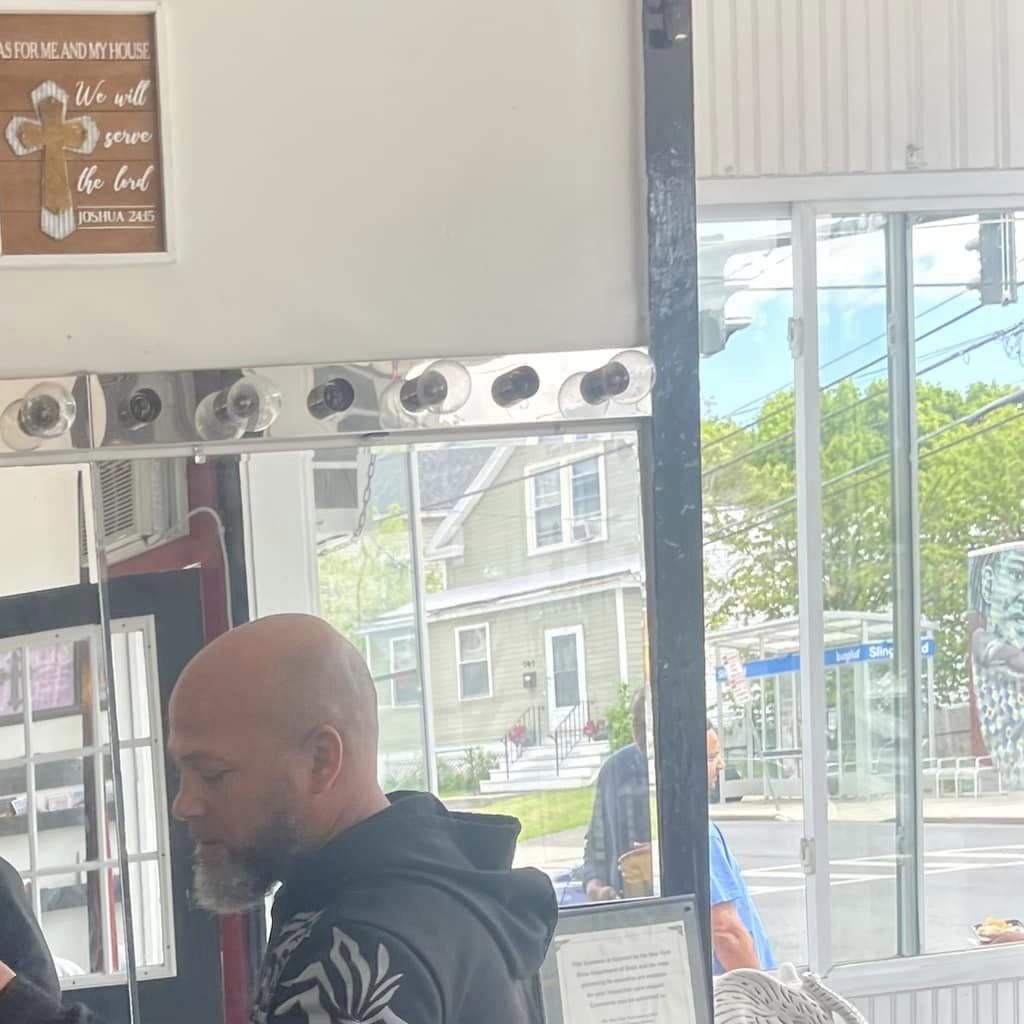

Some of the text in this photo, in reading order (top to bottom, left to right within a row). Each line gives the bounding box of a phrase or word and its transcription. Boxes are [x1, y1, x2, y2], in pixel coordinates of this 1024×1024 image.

[14, 41, 39, 59] FOR
[40, 41, 59, 60] ME
[60, 41, 88, 60] AND
[89, 41, 109, 60] MY
[109, 41, 151, 60] HOUSE
[75, 79, 151, 108] We will
[103, 129, 153, 149] serve
[77, 165, 105, 195] the
[79, 210, 125, 225] JOSHUA
